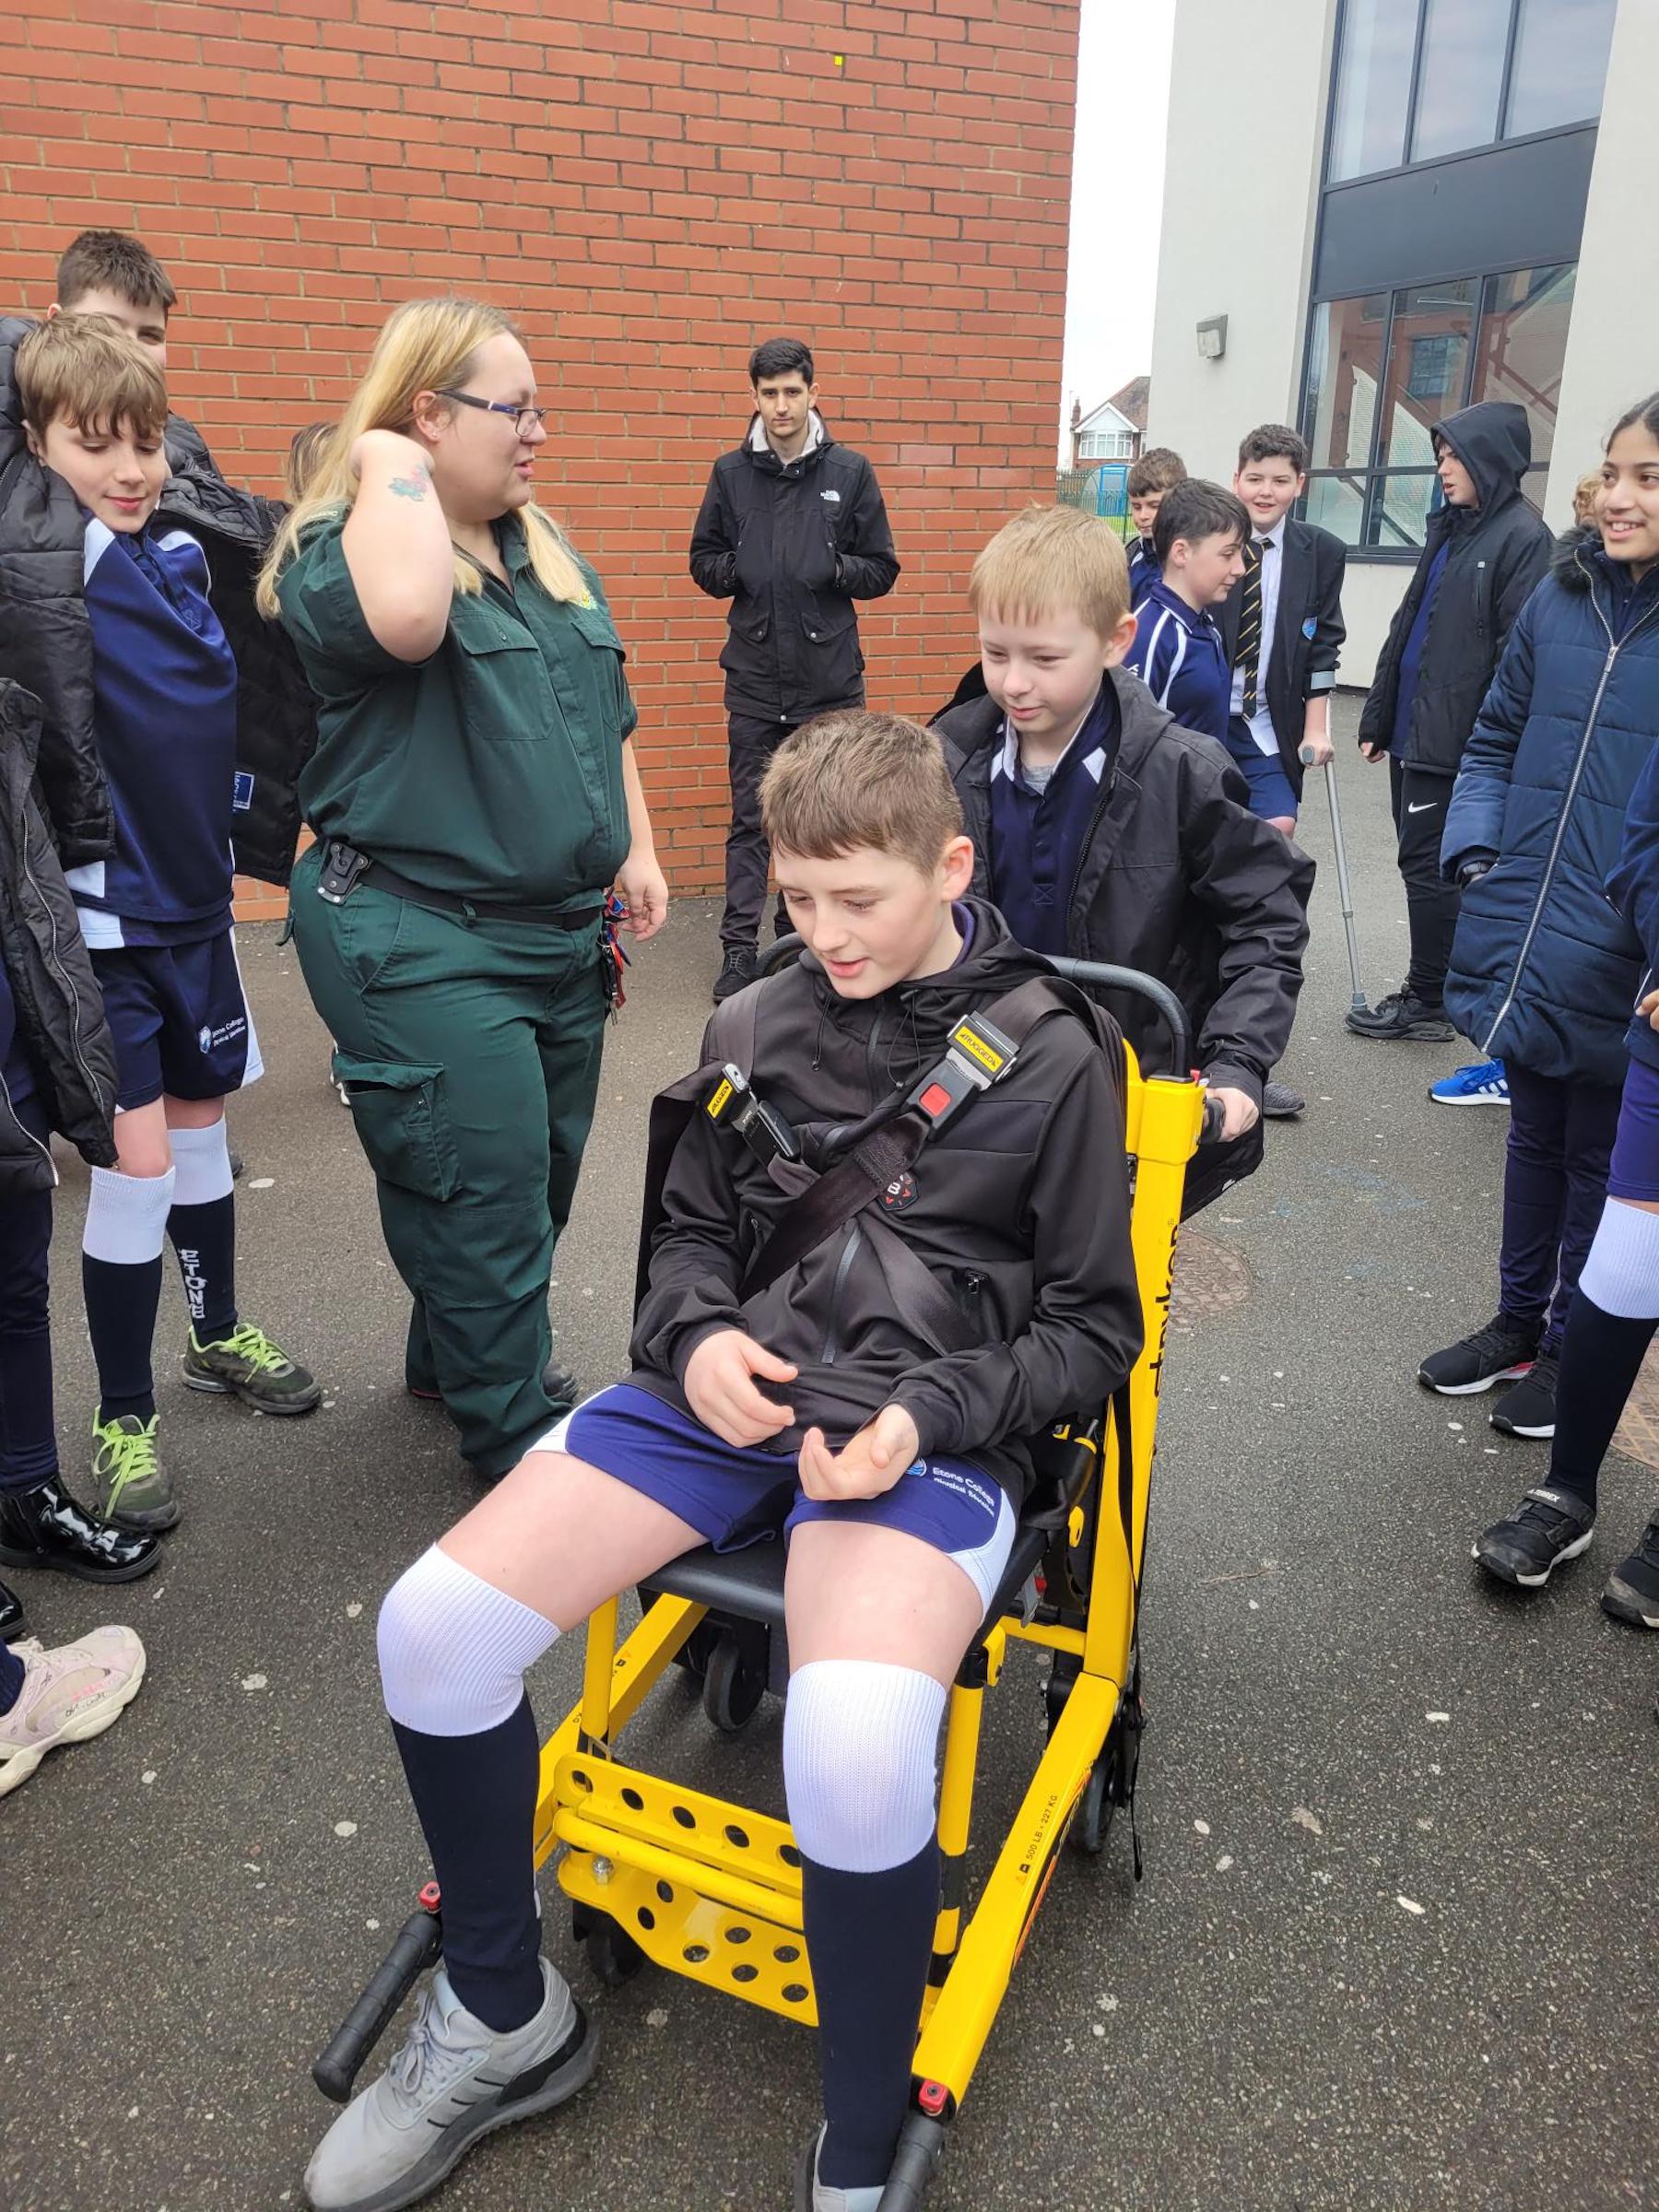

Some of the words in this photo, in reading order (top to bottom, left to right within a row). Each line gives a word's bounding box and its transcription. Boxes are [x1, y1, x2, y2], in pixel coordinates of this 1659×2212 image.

[962, 1033, 994, 1064] RUGGED
[178, 1248, 207, 1319] ETONE
[1025, 1843, 1038, 1861] 500
[1034, 1831, 1043, 1842] LB
[1041, 1808, 1052, 1825] 227
[1049, 1794, 1058, 1807] KG
